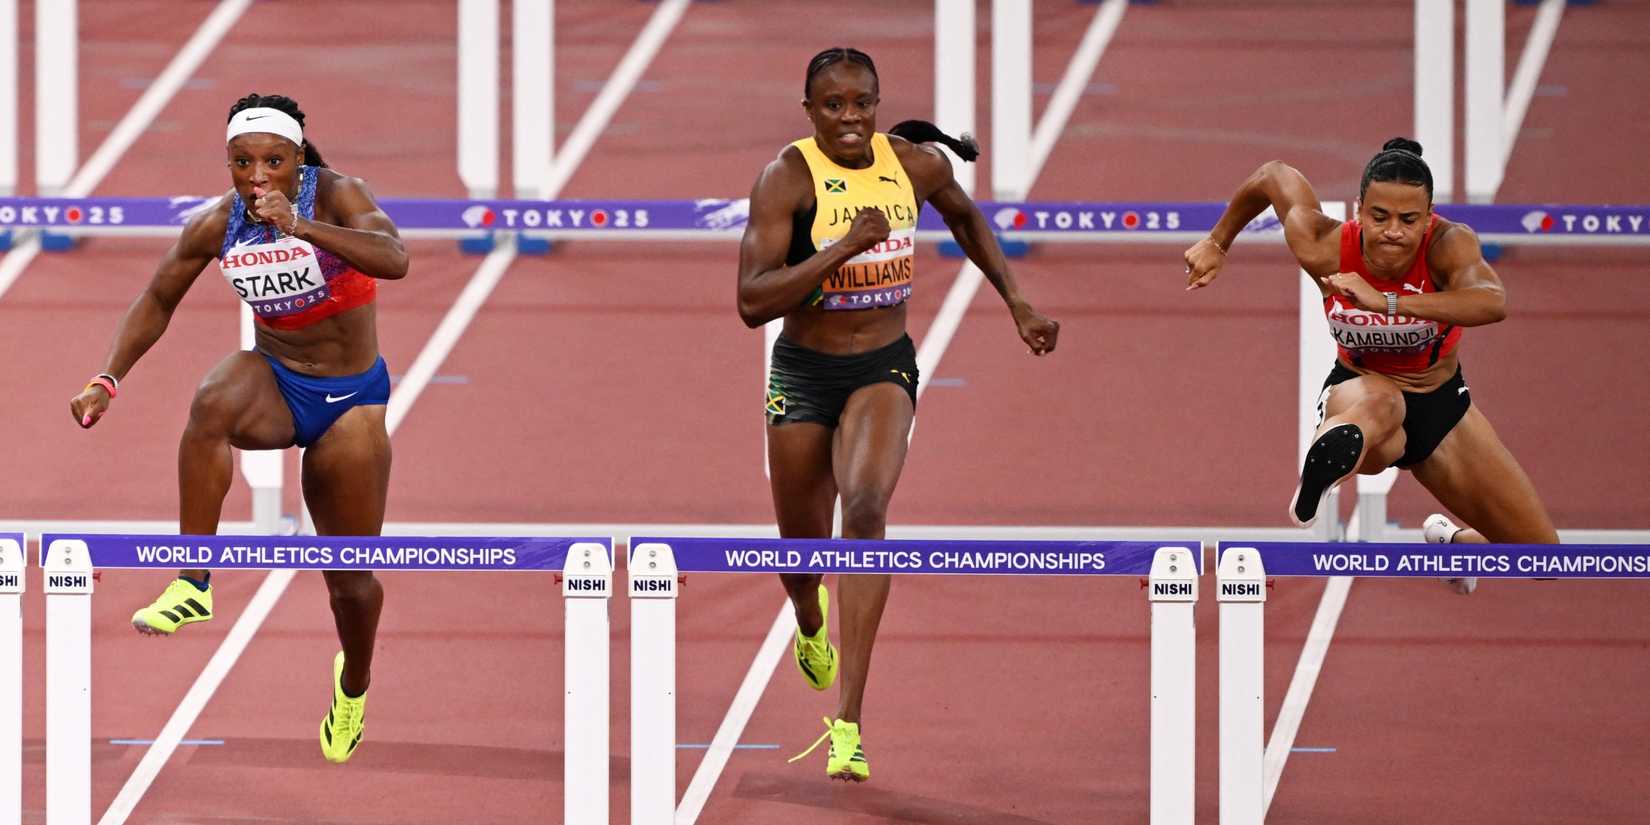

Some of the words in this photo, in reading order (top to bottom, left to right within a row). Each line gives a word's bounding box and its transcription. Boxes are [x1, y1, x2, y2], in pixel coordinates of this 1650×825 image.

[829, 204, 914, 226] JAICA
[1562, 214, 1650, 233] TOKY
[222, 246, 311, 269] HONDA
[232, 267, 316, 298] STARK
[828, 257, 912, 289] WILLIAMS
[1332, 327, 1434, 346] KAMBUNDJI
[136, 546, 213, 563] WORLD
[219, 546, 334, 564] ATHLETICS
[340, 547, 517, 566] CHAMPIONSHIPS
[725, 550, 801, 567] WORLD
[808, 551, 922, 569] ATHLETICS
[928, 551, 1106, 570] CHAMPIONSHIPS
[1313, 554, 1390, 571] WORLD
[1396, 555, 1511, 572] ATHLETICS
[1517, 555, 1650, 573] CHAMPIONS
[49, 575, 87, 588] NISHI
[568, 579, 606, 591] NISHI
[633, 580, 672, 591] NISHI
[1154, 583, 1192, 595] NISHI
[1222, 583, 1260, 595] NISHI
